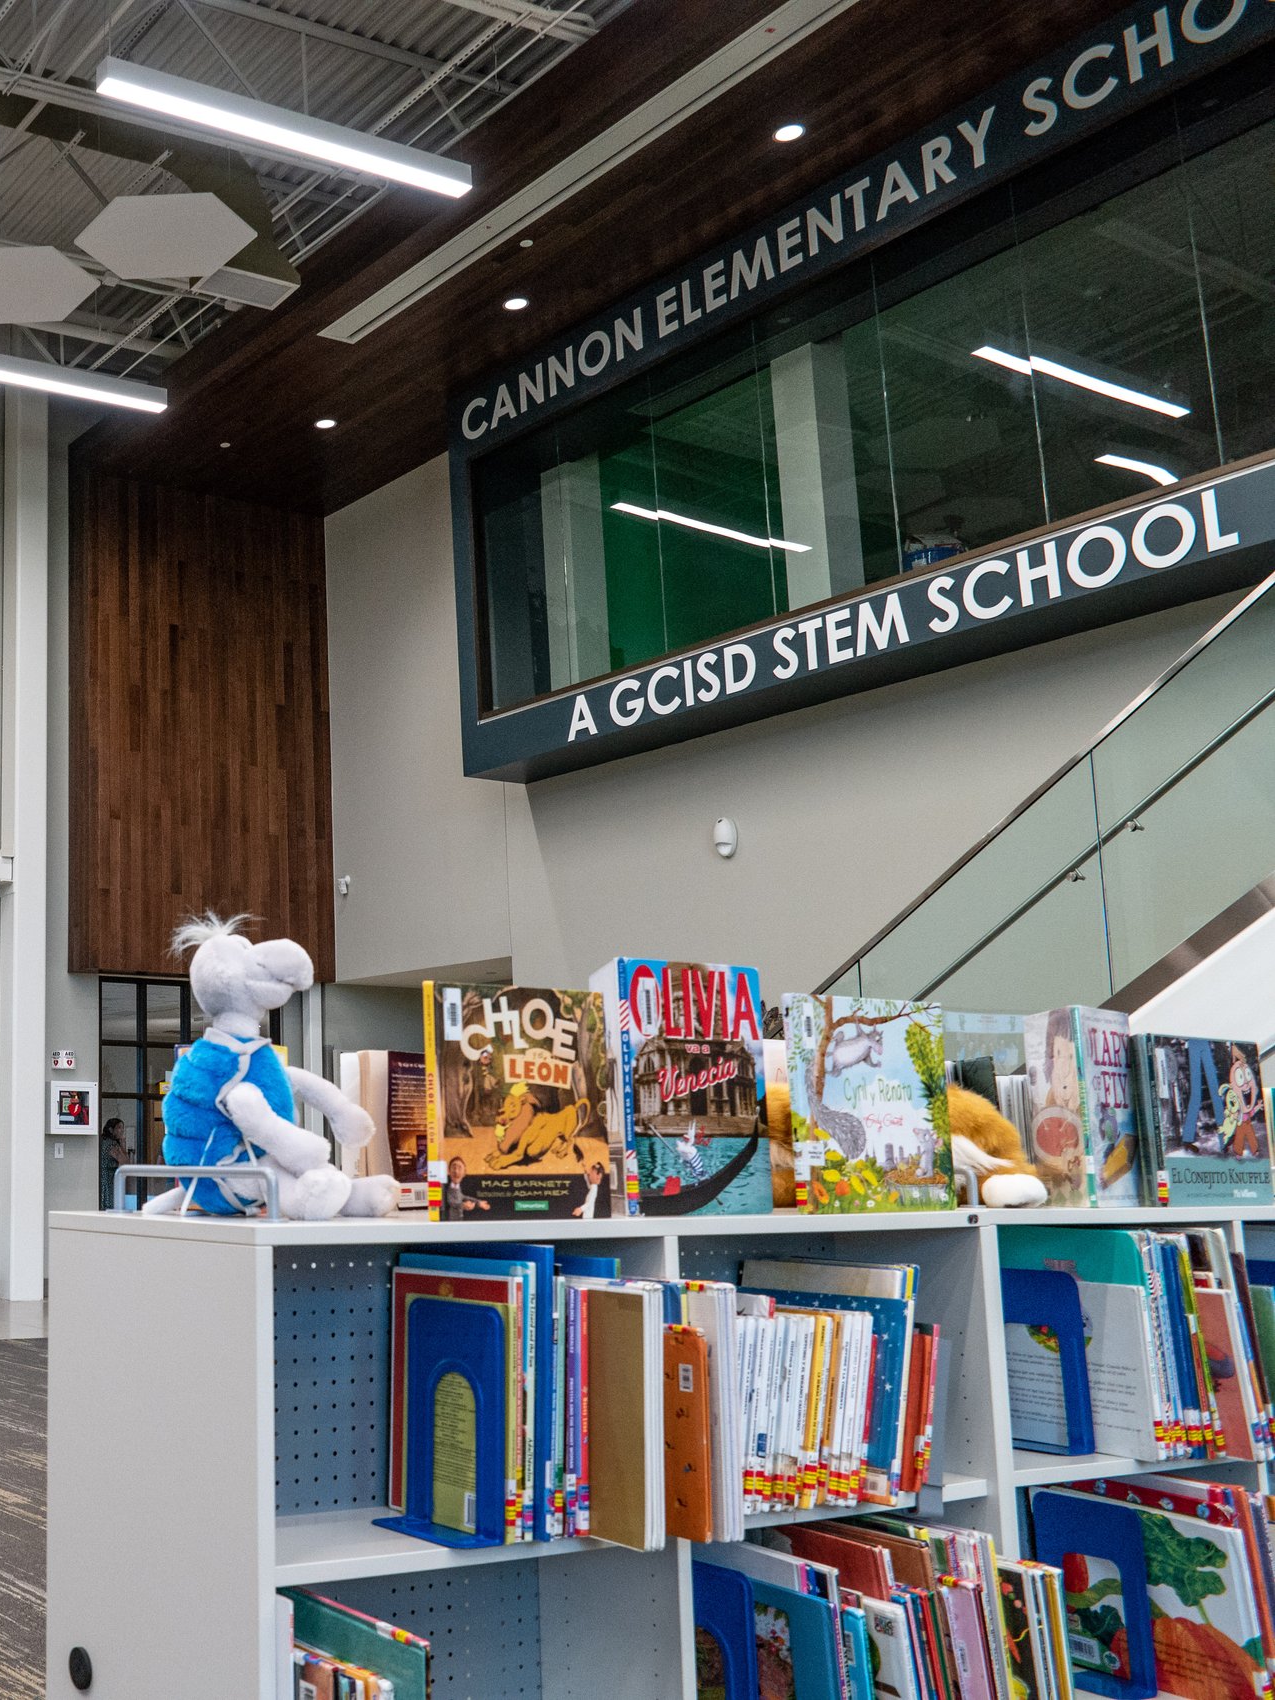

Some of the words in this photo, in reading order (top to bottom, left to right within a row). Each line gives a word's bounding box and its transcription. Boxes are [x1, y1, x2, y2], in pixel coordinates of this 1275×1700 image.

[461, 307, 643, 442] CANNON
[657, 105, 995, 338] ELEMENTARY
[568, 695, 598, 741] A
[609, 643, 756, 727] GCISD
[772, 593, 910, 680] STEM
[927, 489, 1240, 633] SCHOOL
[629, 964, 760, 1041] OLIVIA
[460, 996, 579, 1061] CHLOE
[685, 1044, 701, 1054] va
[701, 1045, 710, 1054] a
[658, 1055, 738, 1102] Venecia
[843, 1076, 867, 1110] Cyril
[877, 1078, 912, 1102] Renata
[1101, 1071, 1129, 1109] FLY
[481, 1180, 511, 1188] MAC
[513, 1180, 572, 1188] BARNETT
[543, 1189, 570, 1197] REX
[1171, 1167, 1182, 1184] EL
[1185, 1168, 1228, 1190] CONEJITO
[1228, 1168, 1271, 1184] KNUFFLE
